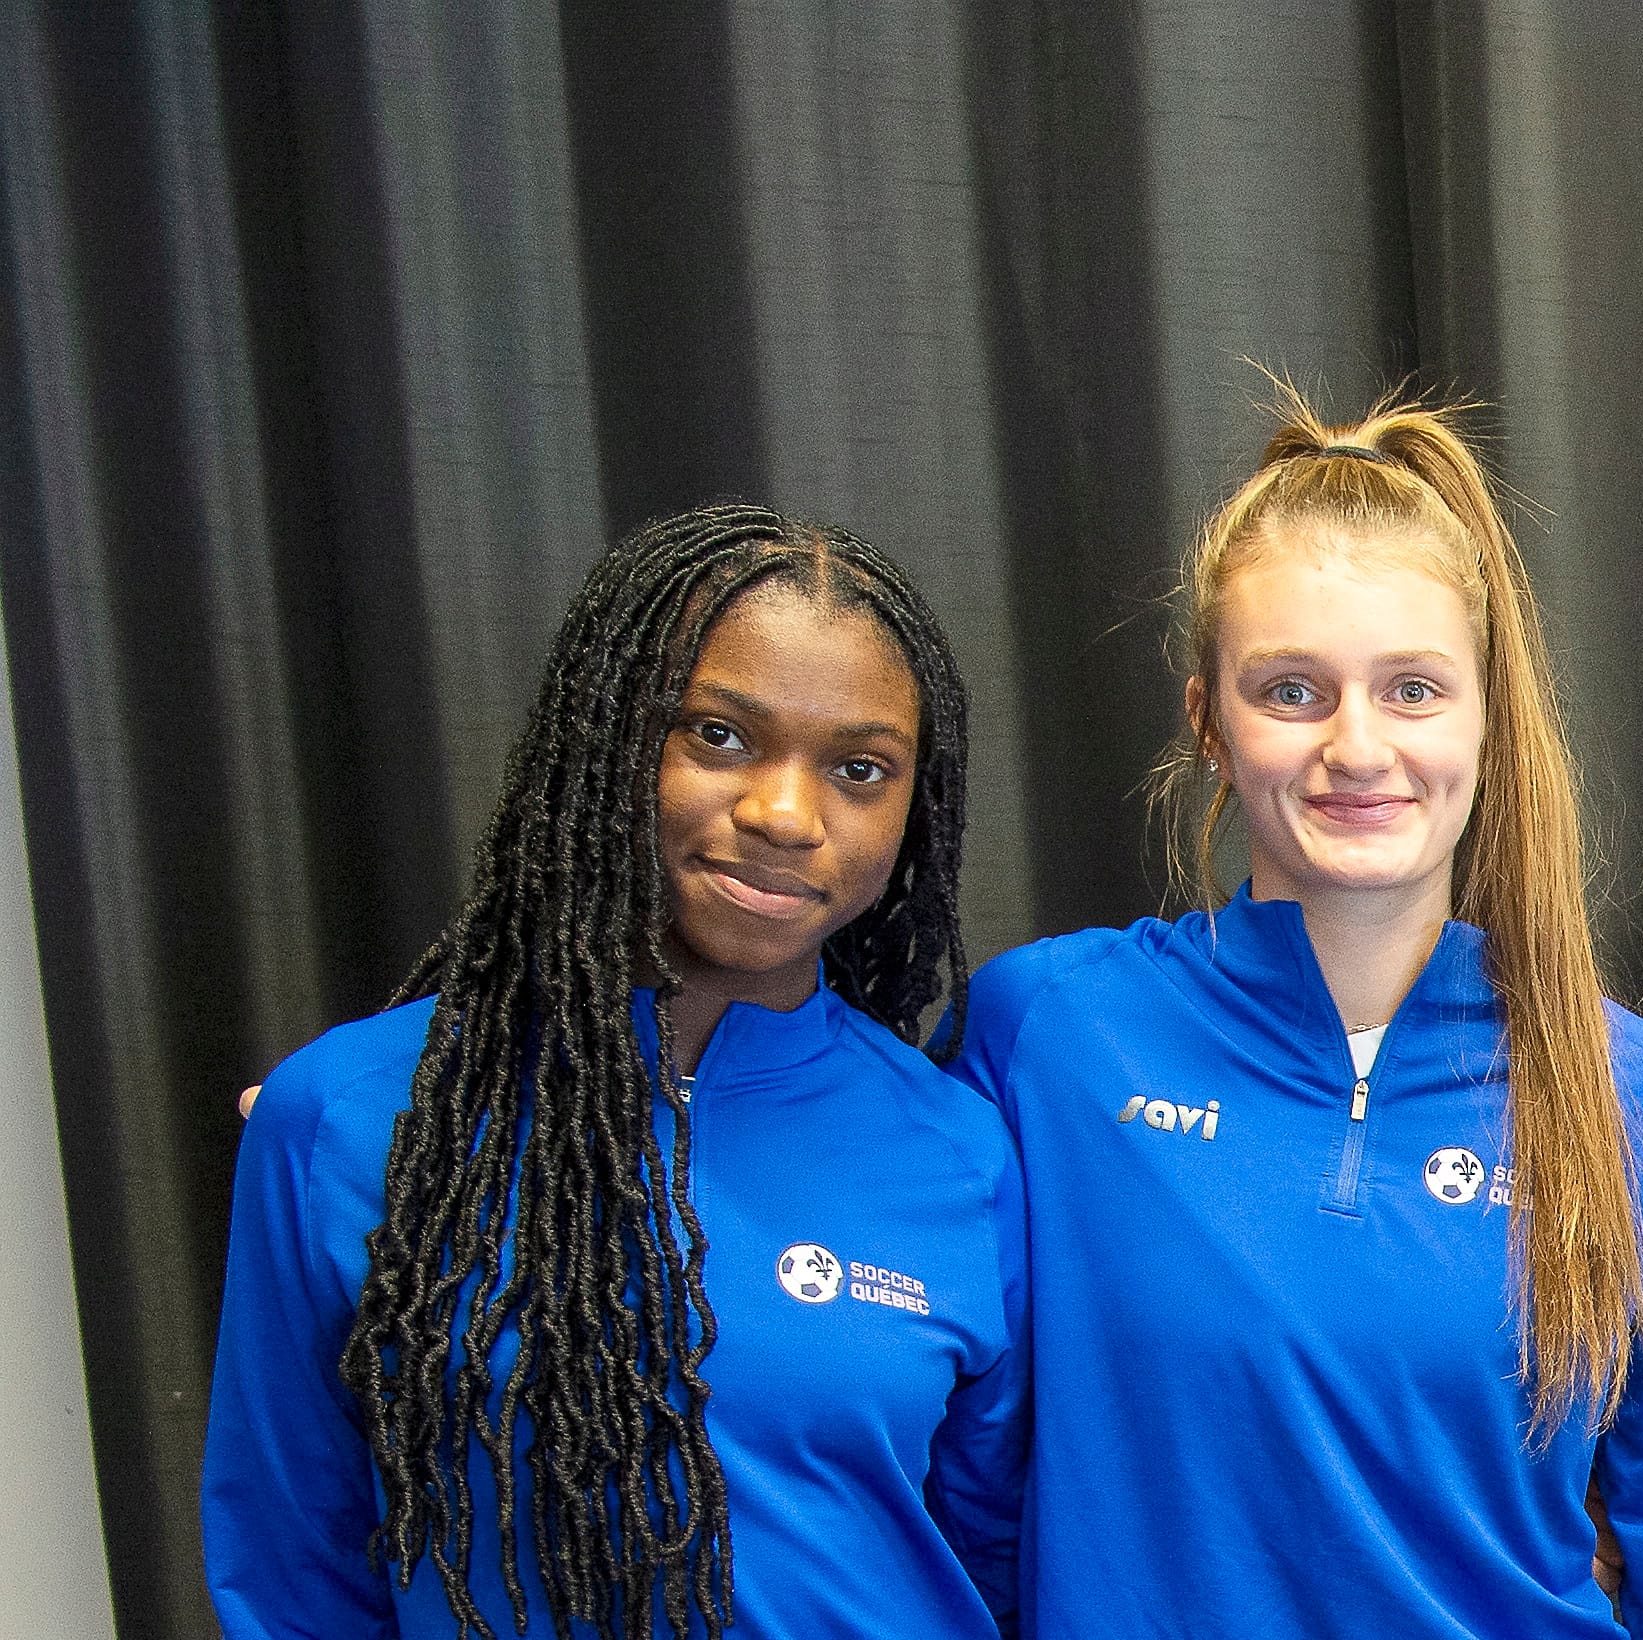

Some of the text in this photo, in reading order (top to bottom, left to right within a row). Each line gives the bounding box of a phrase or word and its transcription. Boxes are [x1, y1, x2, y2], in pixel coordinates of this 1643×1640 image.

[1118, 1095, 1220, 1141] savi
[849, 1261, 926, 1297] SOCCER
[850, 1281, 931, 1316] QUÉBEC
